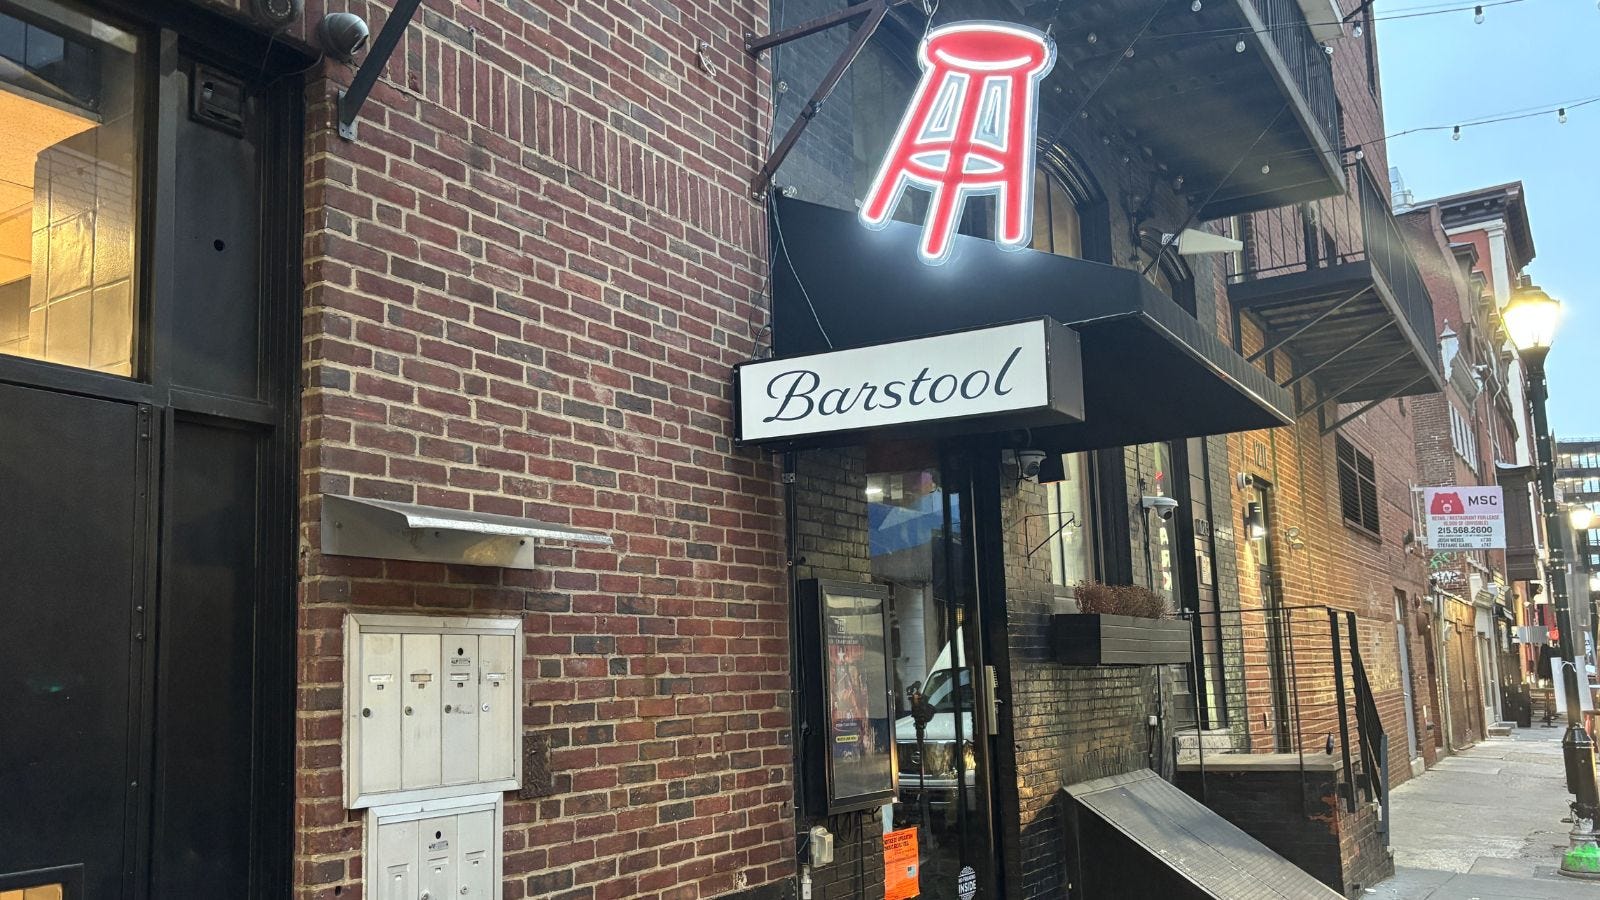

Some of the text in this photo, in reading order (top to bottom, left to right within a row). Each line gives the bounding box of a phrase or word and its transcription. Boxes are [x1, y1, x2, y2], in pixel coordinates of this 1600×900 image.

[762, 346, 1023, 423] Barstool
[1468, 495, 1497, 506] MSC
[1437, 526, 1493, 534] 215.568.2600
[958, 879, 977, 894] INSIDE
